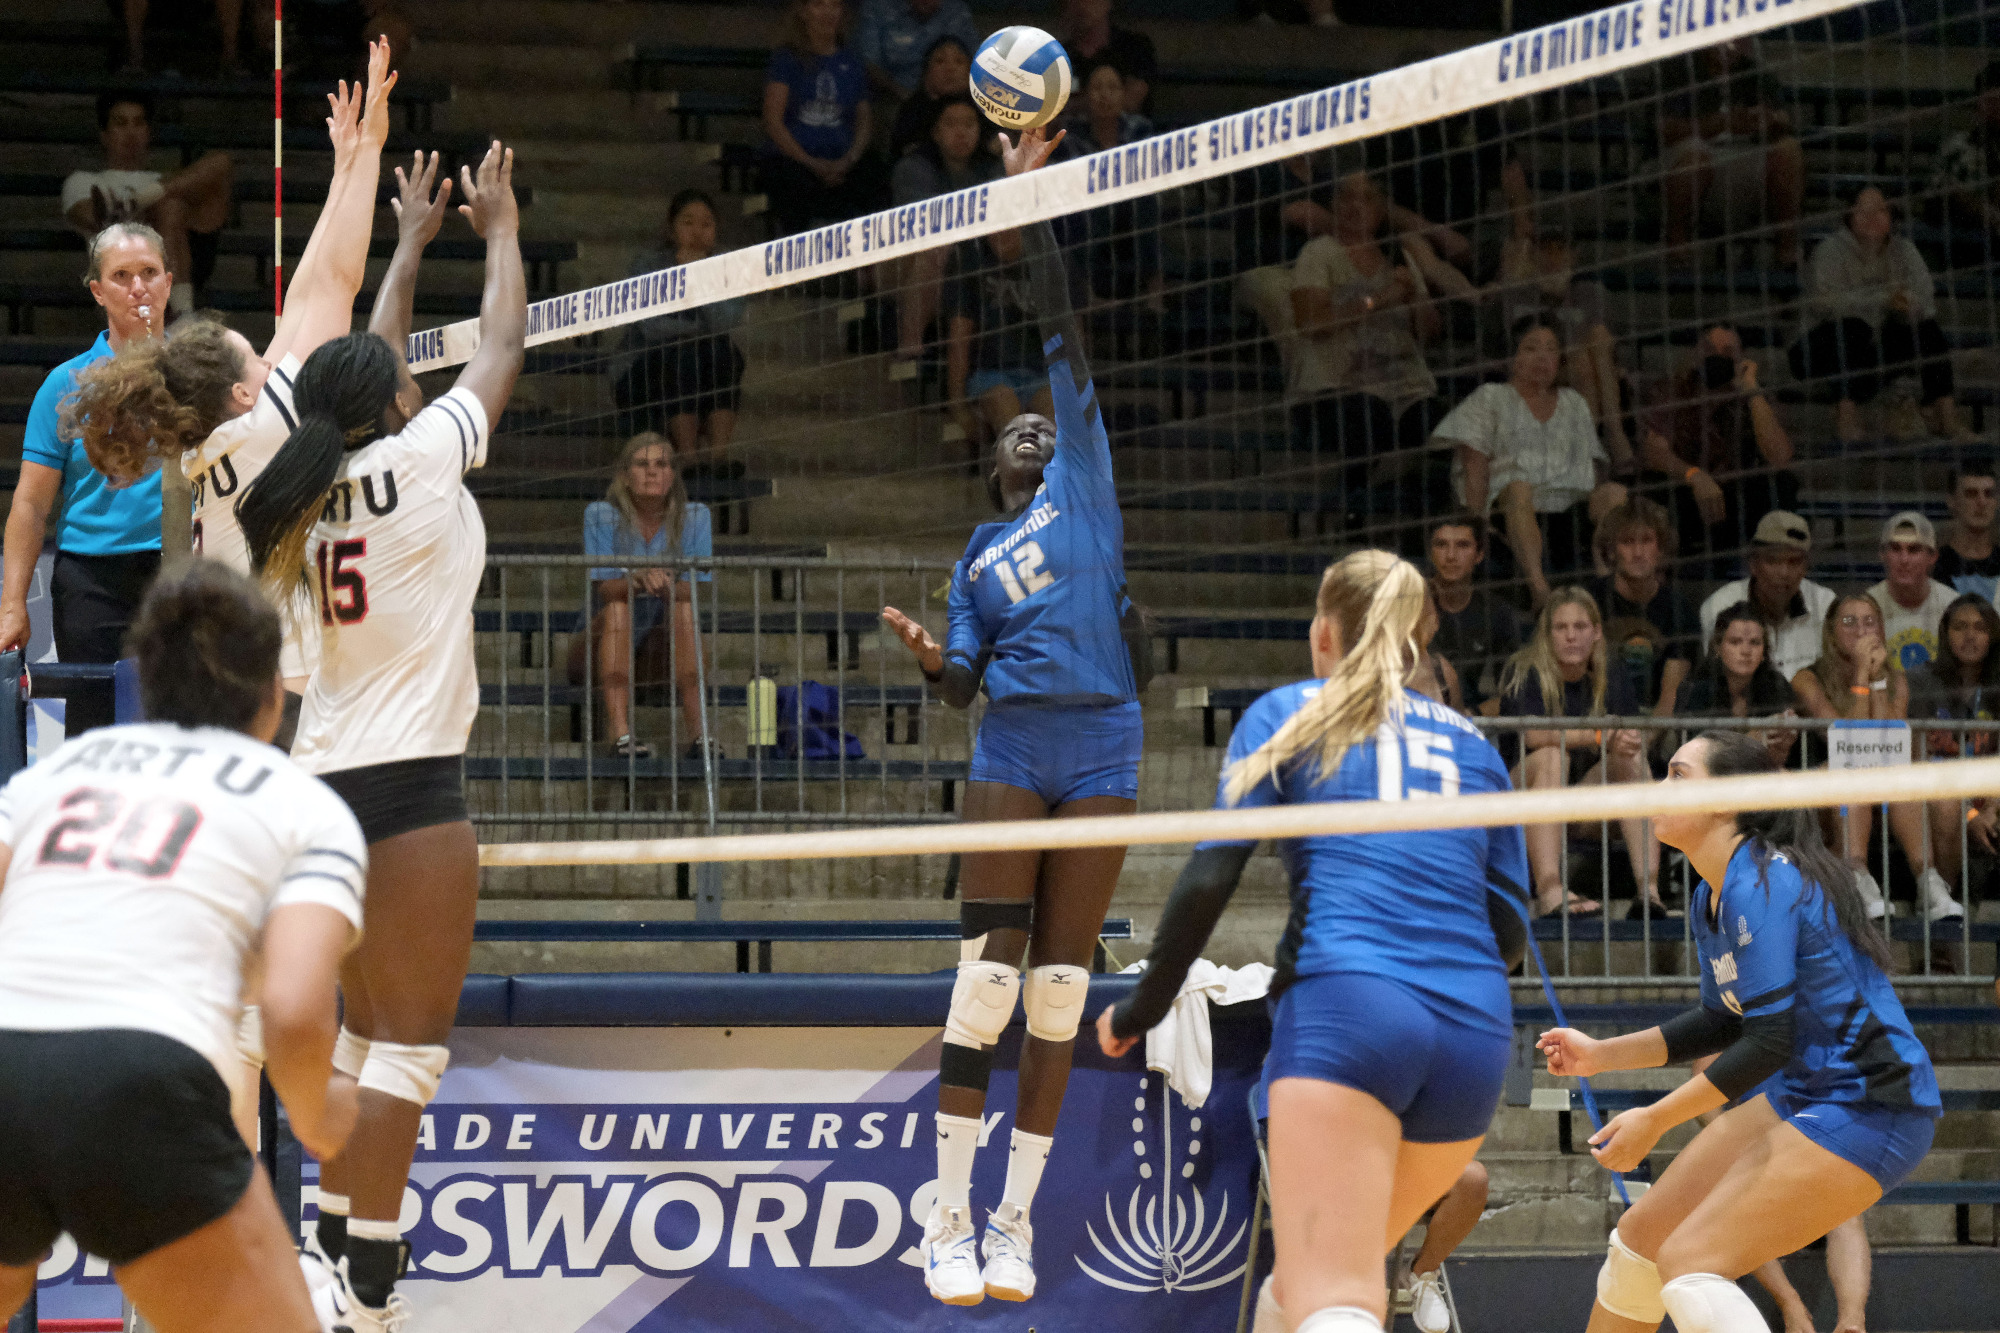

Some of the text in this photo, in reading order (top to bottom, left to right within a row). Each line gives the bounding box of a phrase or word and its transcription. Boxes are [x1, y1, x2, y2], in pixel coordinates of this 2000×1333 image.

[1087, 80, 1371, 194] CHAMINADE SILVERSWORDS
[764, 187, 989, 277] CHAMINADE SILVERSWORDS
[584, 267, 687, 322] SILVERSWORDS
[208, 453, 238, 498] U
[360, 469, 399, 517] U
[968, 502, 1060, 582] CHAMINADE
[994, 541, 1055, 605] 12
[316, 537, 369, 627] 15
[52, 739, 273, 797] ART U
[1376, 722, 1460, 802] 15
[1836, 741, 1903, 755] Reserved
[38, 786, 205, 880] 20
[578, 1112, 1005, 1150] UNIVERSIY
